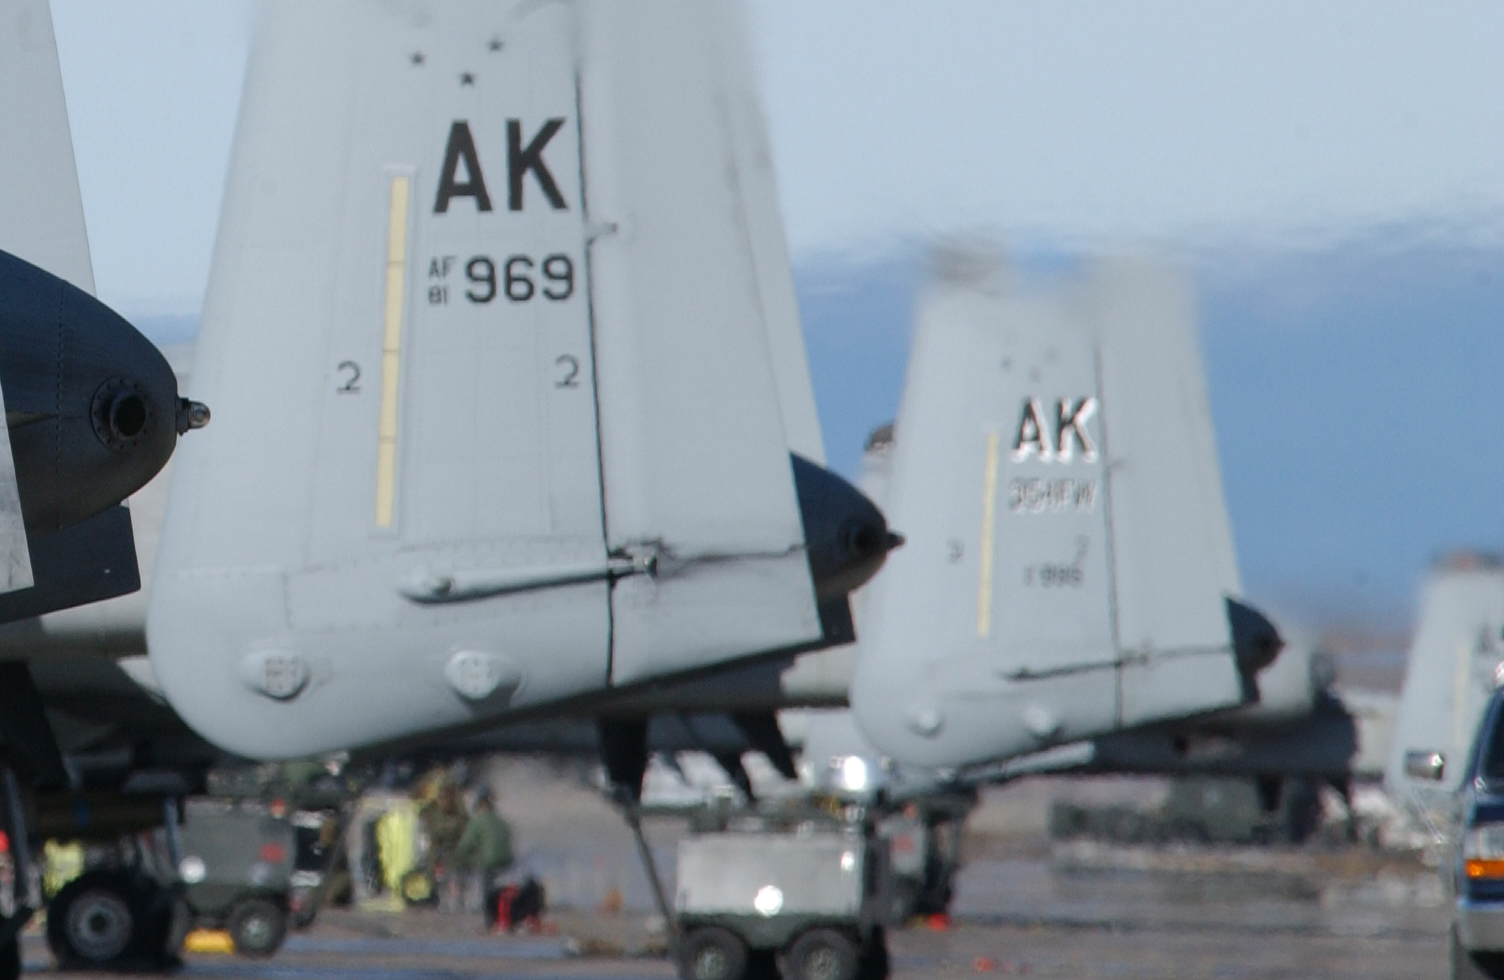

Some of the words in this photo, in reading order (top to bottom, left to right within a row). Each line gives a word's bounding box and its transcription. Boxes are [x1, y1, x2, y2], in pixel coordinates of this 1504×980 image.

[432, 117, 568, 214] AK
[465, 253, 575, 304] 969
[336, 360, 362, 395] 2
[554, 354, 581, 389] 2
[1008, 396, 1098, 463] AK
